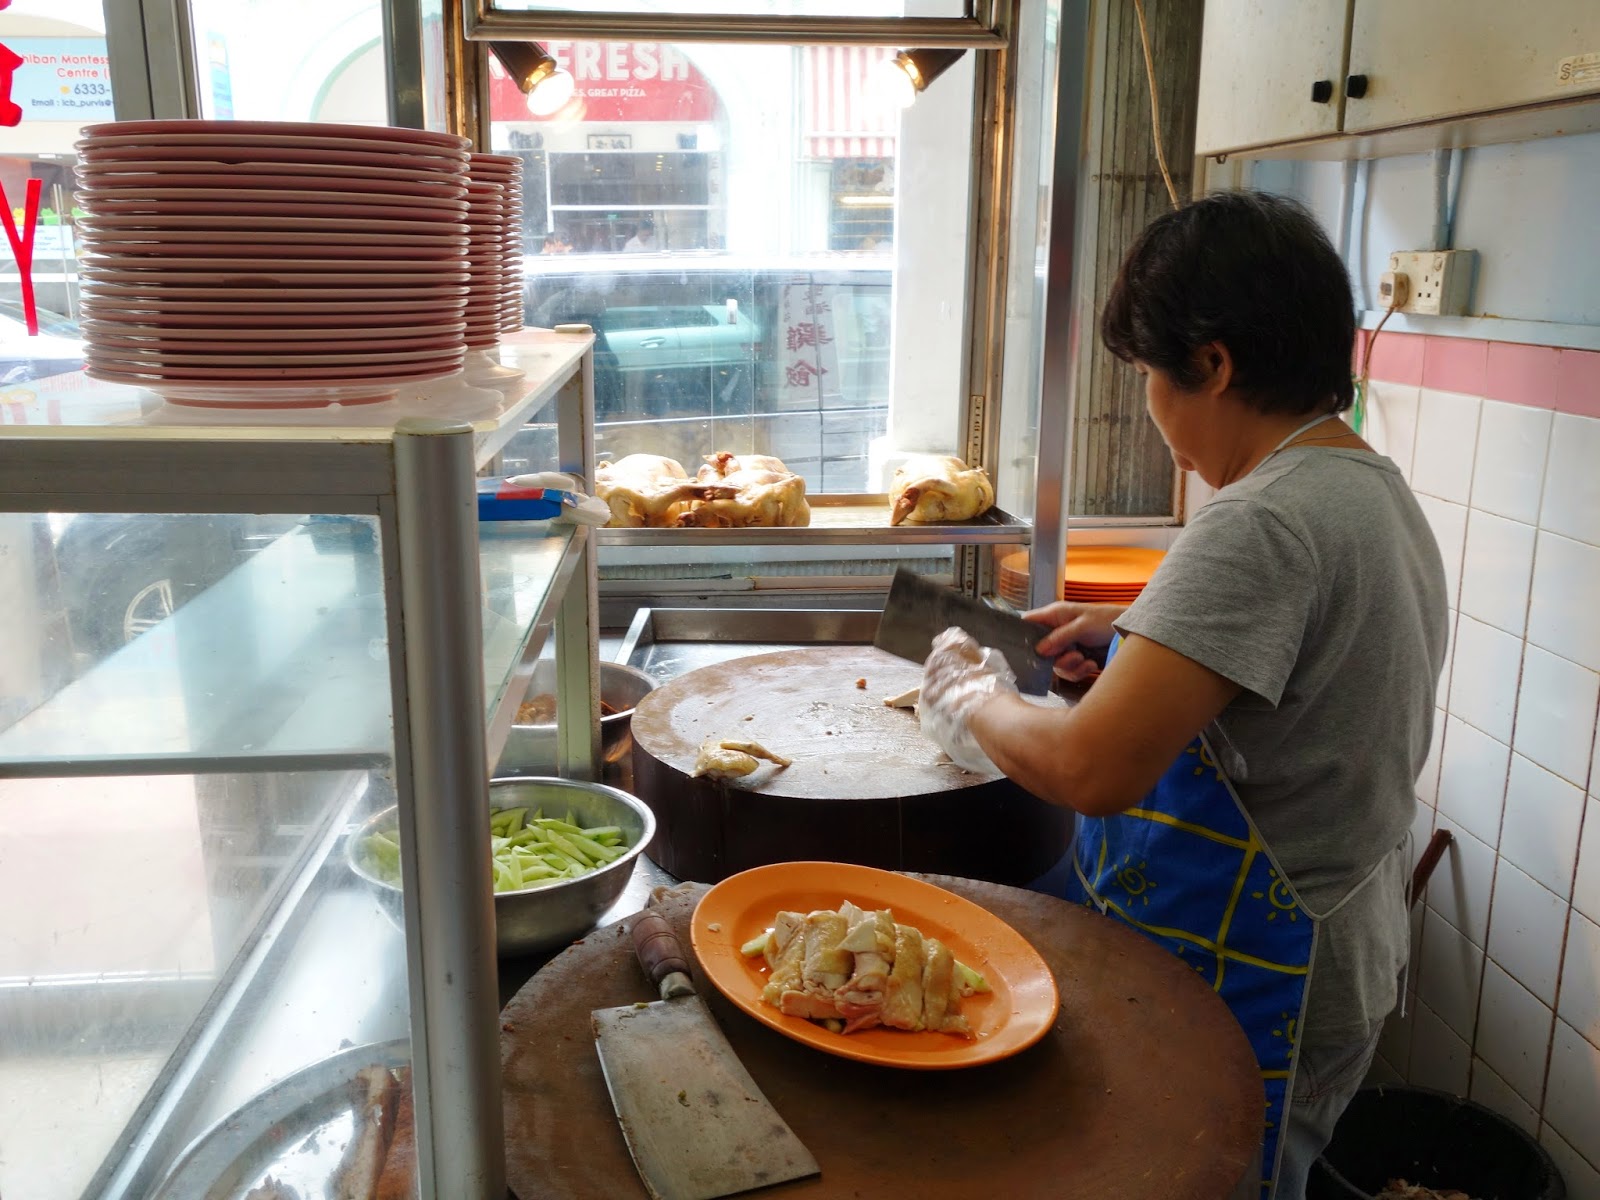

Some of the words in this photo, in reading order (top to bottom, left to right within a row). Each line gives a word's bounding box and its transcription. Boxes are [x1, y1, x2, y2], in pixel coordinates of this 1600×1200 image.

[22, 54, 57, 64] hiban
[61, 55, 110, 65] Montess
[547, 41, 690, 81] FRESH
[56, 67, 98, 78] Centre
[74, 83, 110, 95] 6333-
[587, 88, 619, 97] GREAT
[620, 87, 646, 97] PIZZA
